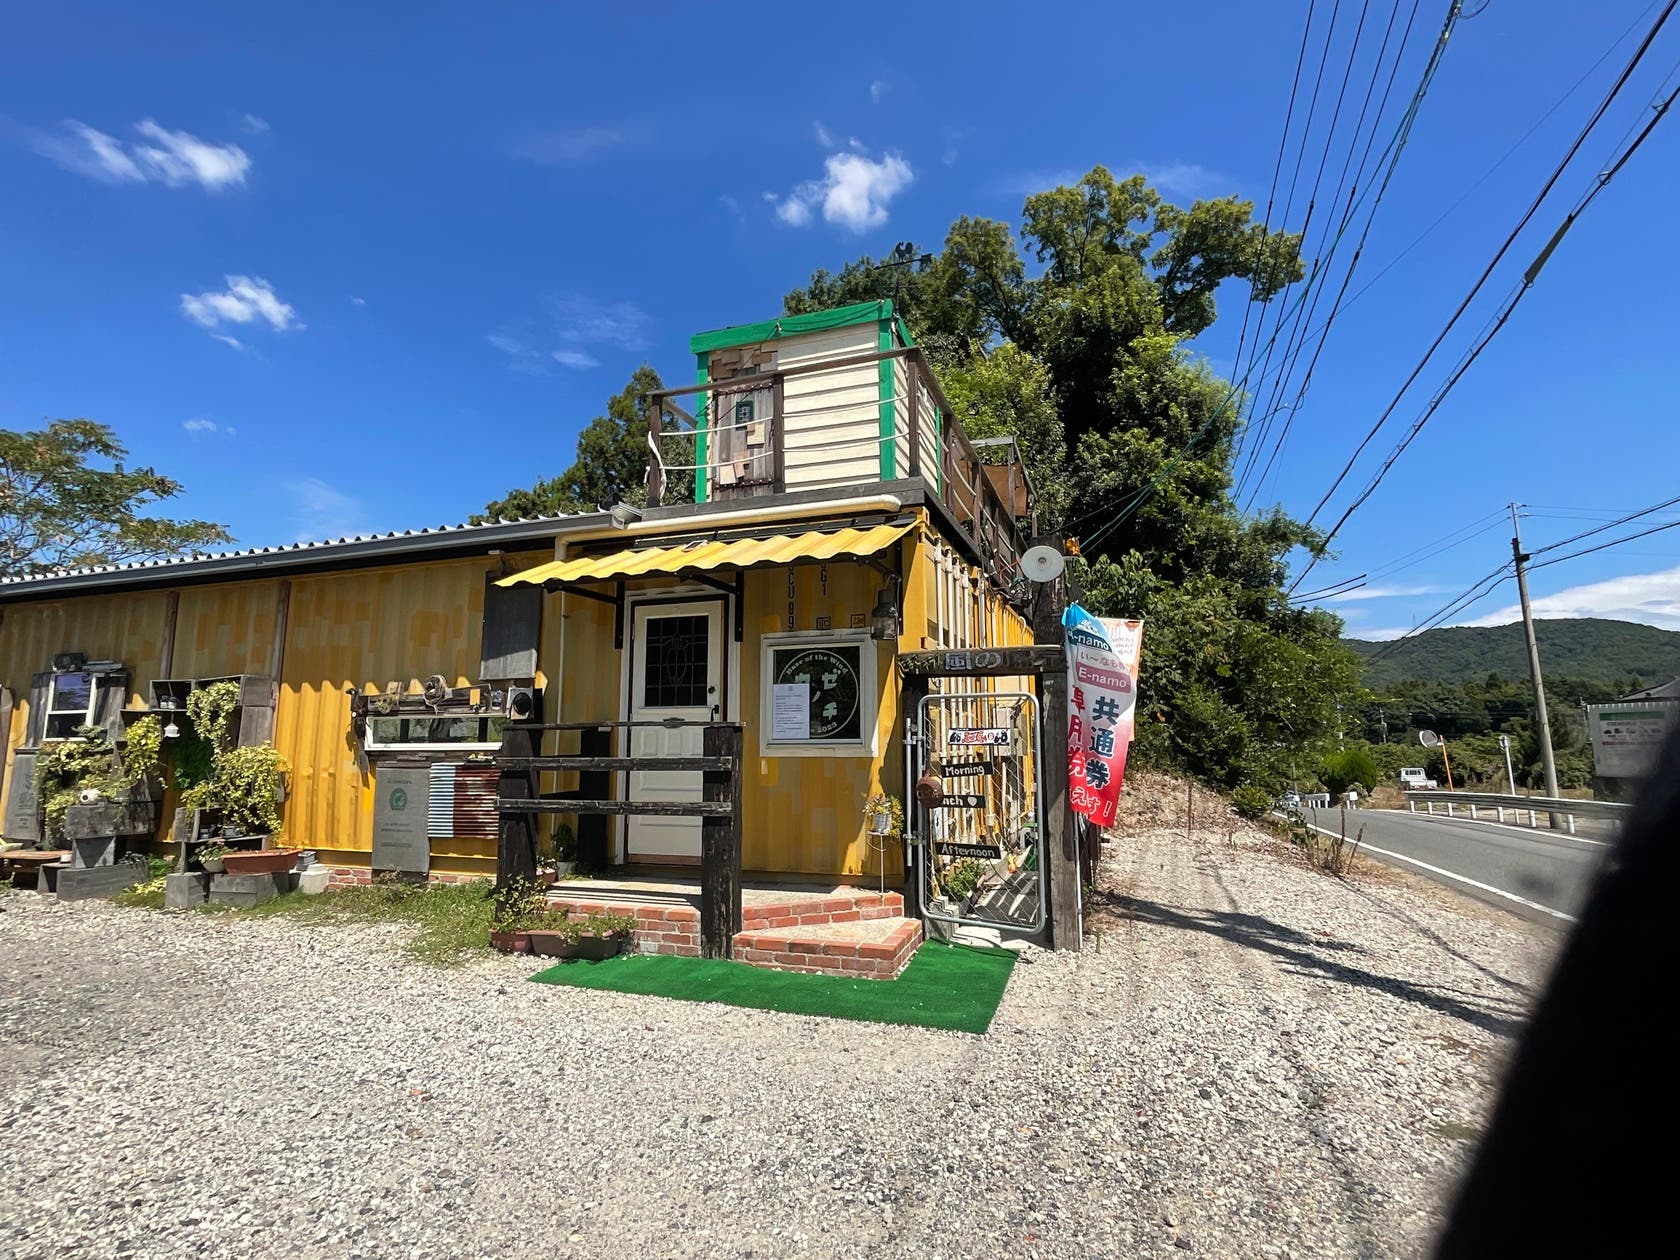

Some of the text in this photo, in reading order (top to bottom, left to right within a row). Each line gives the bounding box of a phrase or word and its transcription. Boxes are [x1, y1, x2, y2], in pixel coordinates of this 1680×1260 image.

[804, 654, 814, 662] of
[1079, 667, 1127, 688] E-namo
[1086, 696, 1119, 790] 共通券
[945, 765, 985, 776] Morning
[942, 796, 963, 806] nch
[941, 844, 995, 858] Afternoon
